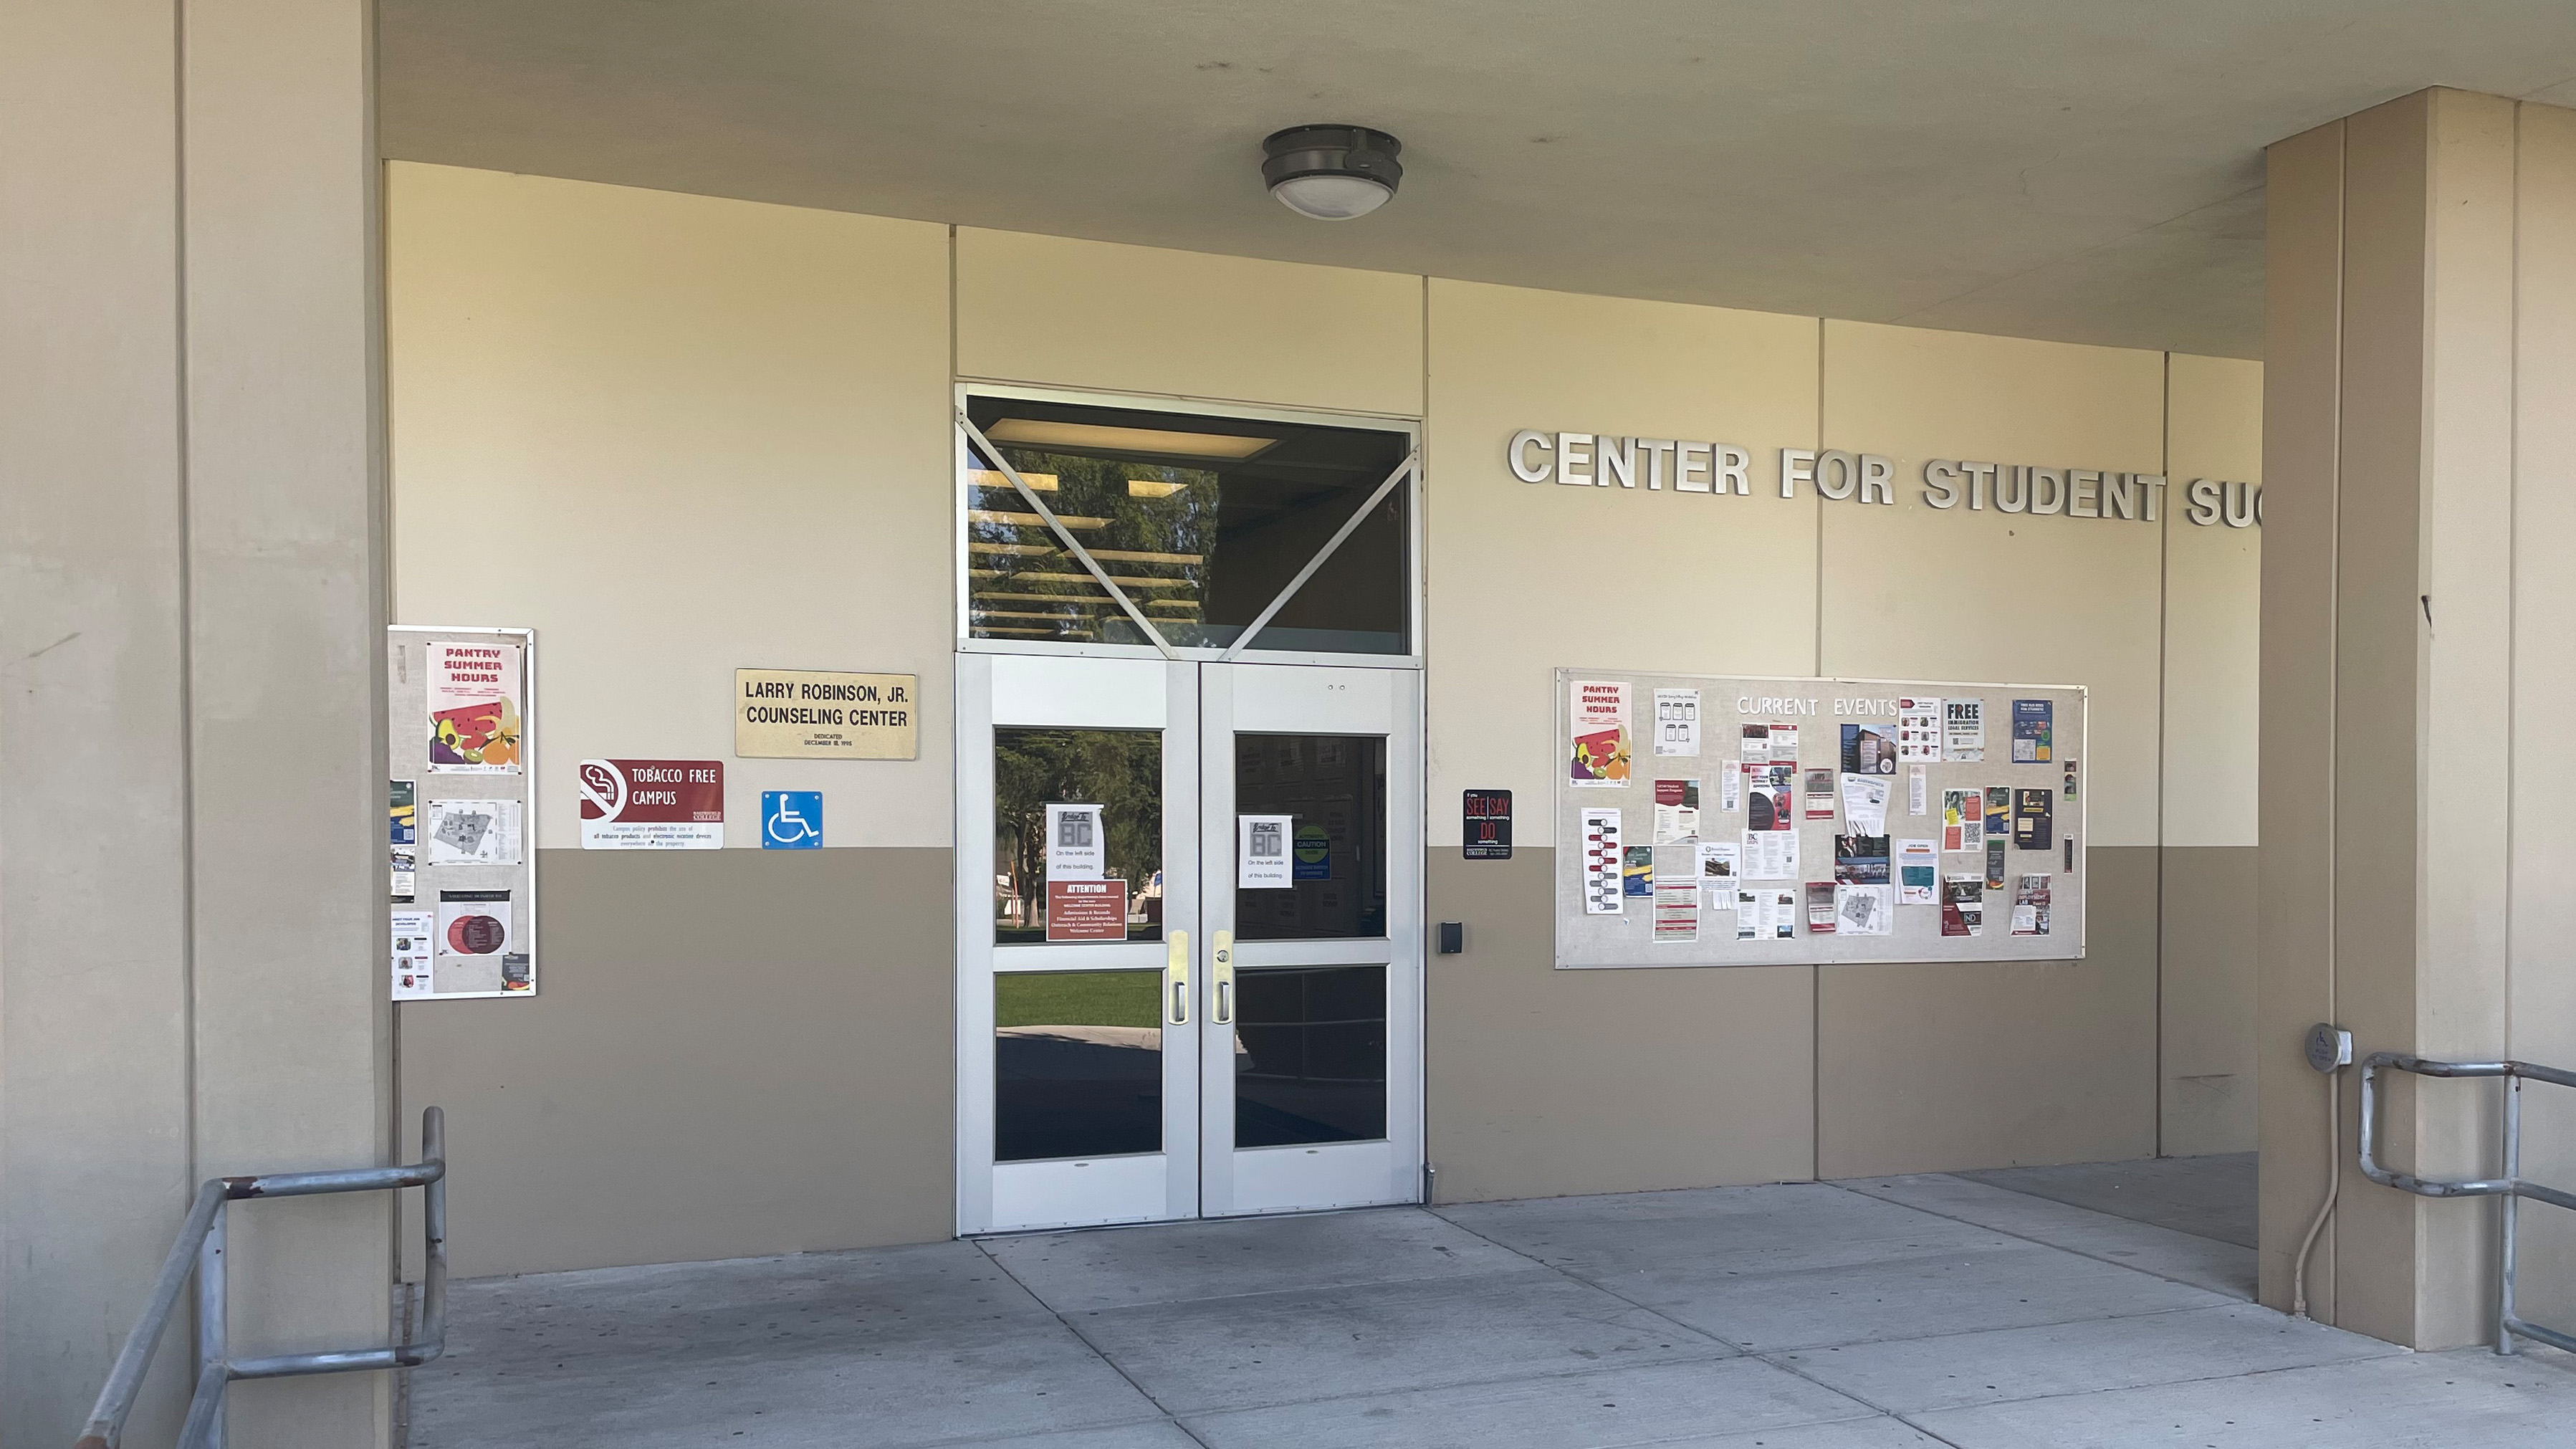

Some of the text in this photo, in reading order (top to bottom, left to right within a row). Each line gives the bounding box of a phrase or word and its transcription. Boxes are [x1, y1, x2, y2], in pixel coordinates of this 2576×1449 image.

[1508, 429, 2262, 529] CENTER FOR STUDENT SU
[446, 648, 501, 658] PANTRY
[444, 660, 502, 670] SUMMER
[451, 673, 499, 682] HOURS
[745, 682, 909, 705] LARRY ROBINSON, JR.
[1583, 685, 1619, 694] PANTRY
[1582, 695, 1620, 704] SUMMER
[1736, 696, 1898, 717] CURRENT EVENTS
[747, 706, 907, 727] COUNSELING CENTER
[1948, 704, 1978, 719] FREE
[632, 768, 717, 783] TOBACCO FREE
[632, 790, 676, 805] CAMPUS
[1466, 798, 1509, 816] SEE SAY
[1060, 823, 1091, 846] BC
[1480, 822, 1495, 840] DO
[1251, 833, 1281, 856] BC
[1066, 884, 1107, 894] ATTENTION
